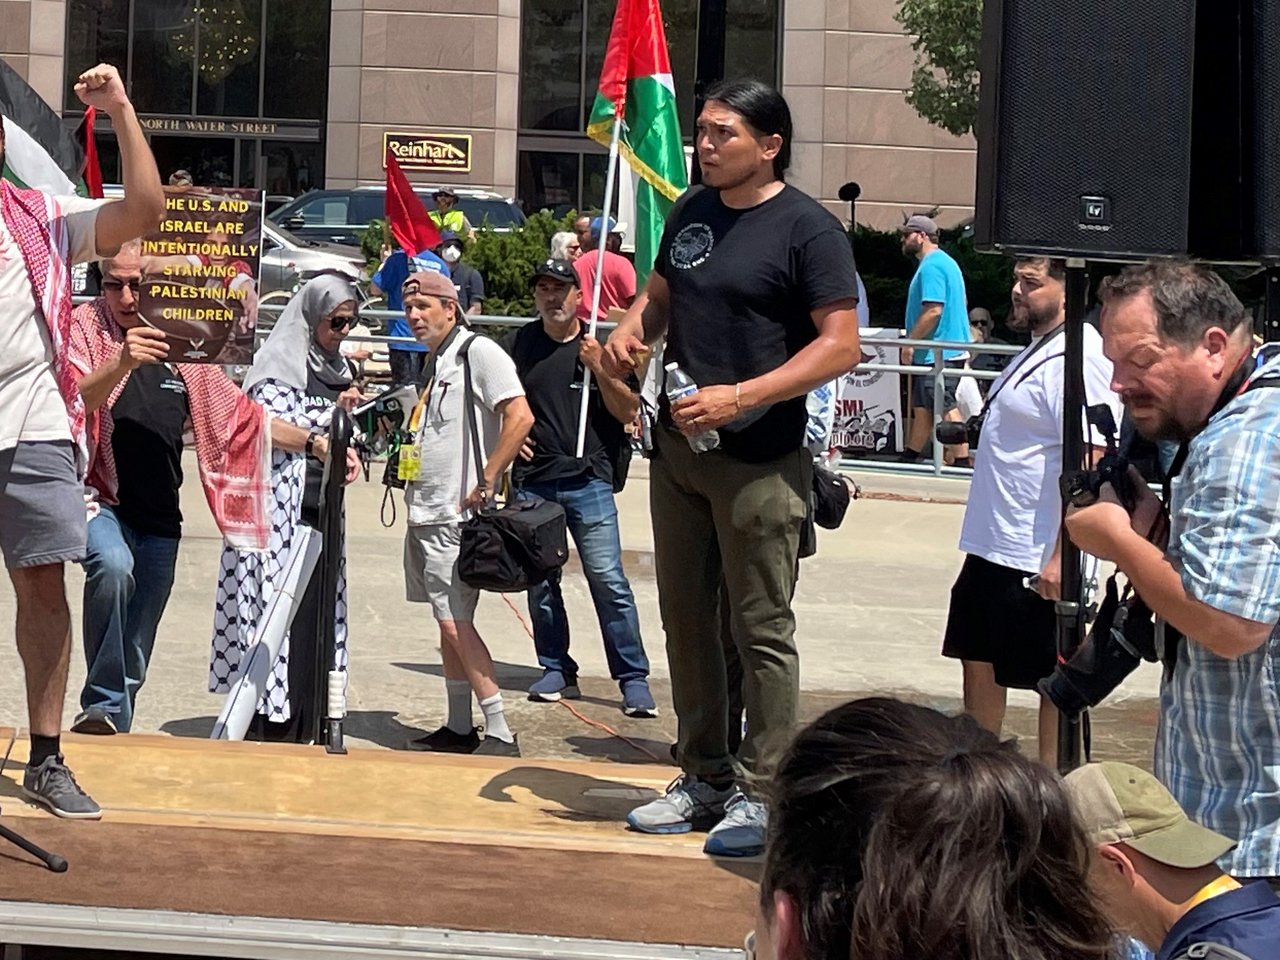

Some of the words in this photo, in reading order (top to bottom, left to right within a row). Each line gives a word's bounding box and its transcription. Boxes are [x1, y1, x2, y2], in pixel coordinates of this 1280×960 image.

[140, 119, 180, 130] NORTH
[185, 121, 225, 132] WATER
[231, 123, 277, 134] STREET
[389, 140, 455, 159] Reinhart
[166, 198, 185, 211] HE
[188, 199, 215, 212] U.S.
[218, 200, 249, 213] AND
[160, 220, 211, 233] ISRAEL
[215, 222, 244, 234] ARE
[143, 240, 259, 257] INTENTIONALLY
[163, 264, 237, 278] STARVING
[151, 285, 247, 300] PALESTINIAN
[162, 307, 234, 321] CHILDREN
